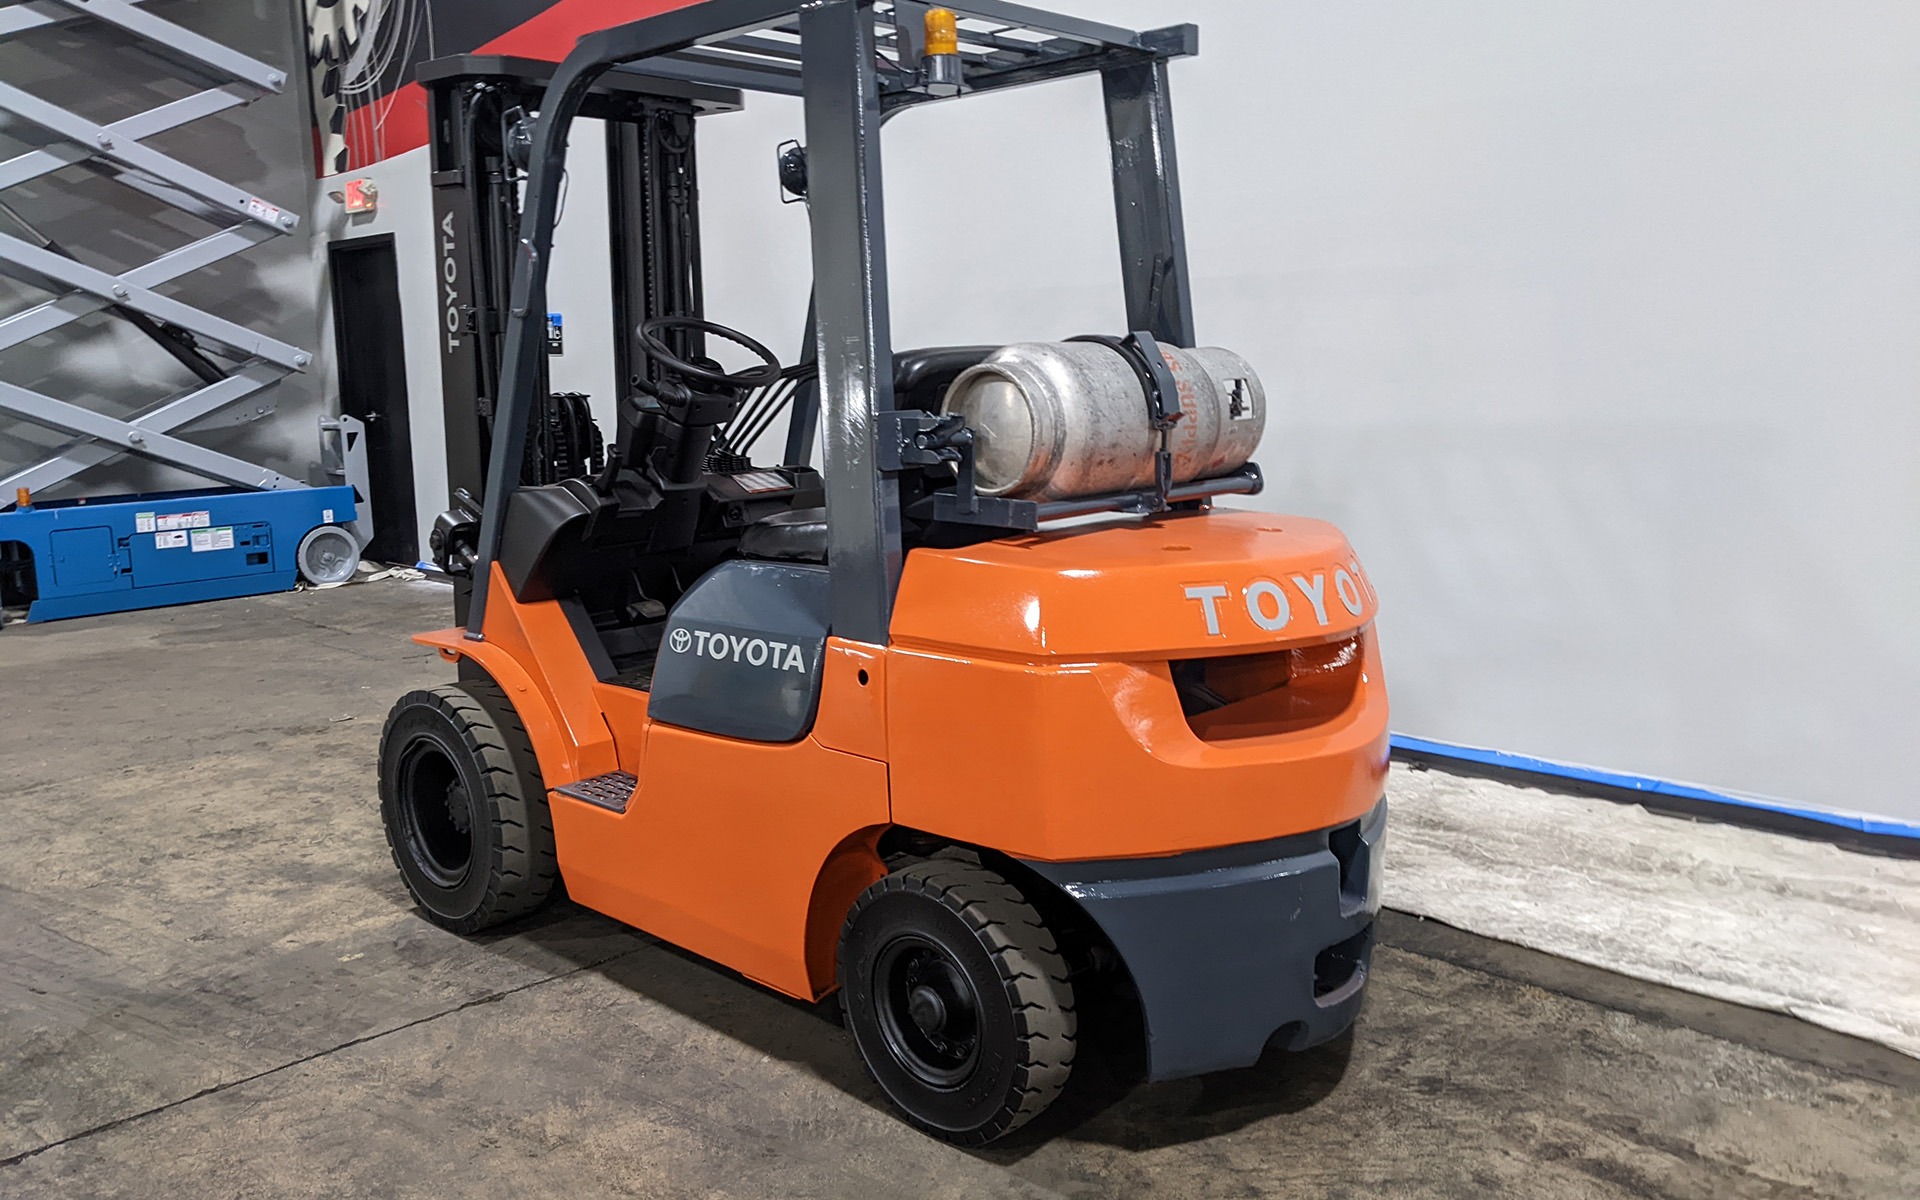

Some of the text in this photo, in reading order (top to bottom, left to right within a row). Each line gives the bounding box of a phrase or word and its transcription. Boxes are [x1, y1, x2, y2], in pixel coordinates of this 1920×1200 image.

[442, 211, 460, 354] TOYOTA
[1184, 561, 1374, 636] TOYOT
[694, 630, 806, 673] TOYOTA
